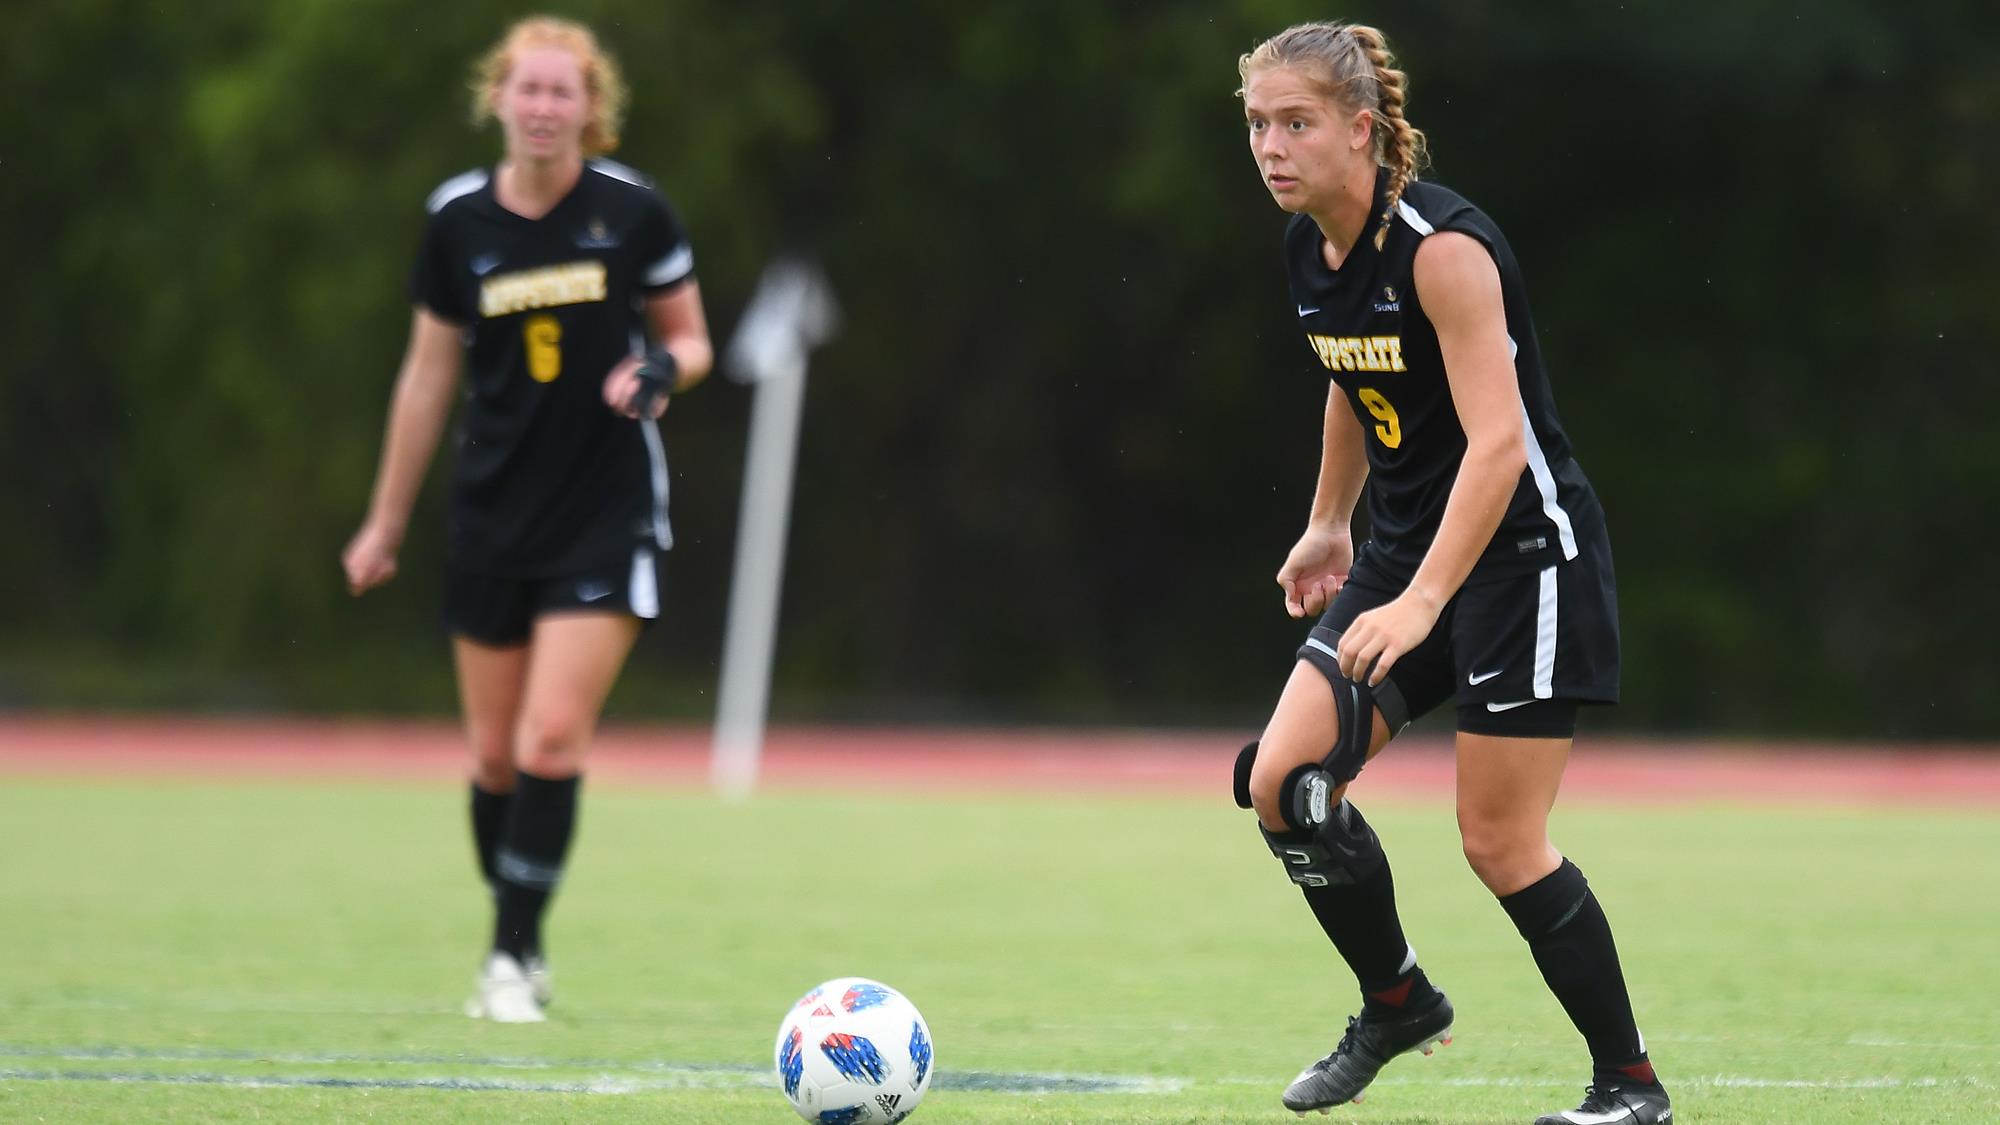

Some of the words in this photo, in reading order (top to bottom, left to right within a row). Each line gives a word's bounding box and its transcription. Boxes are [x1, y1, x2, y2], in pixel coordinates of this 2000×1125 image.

[525, 315, 562, 383] 6
[1307, 333, 1407, 373] PPSTATE
[1358, 388, 1402, 449] 9
